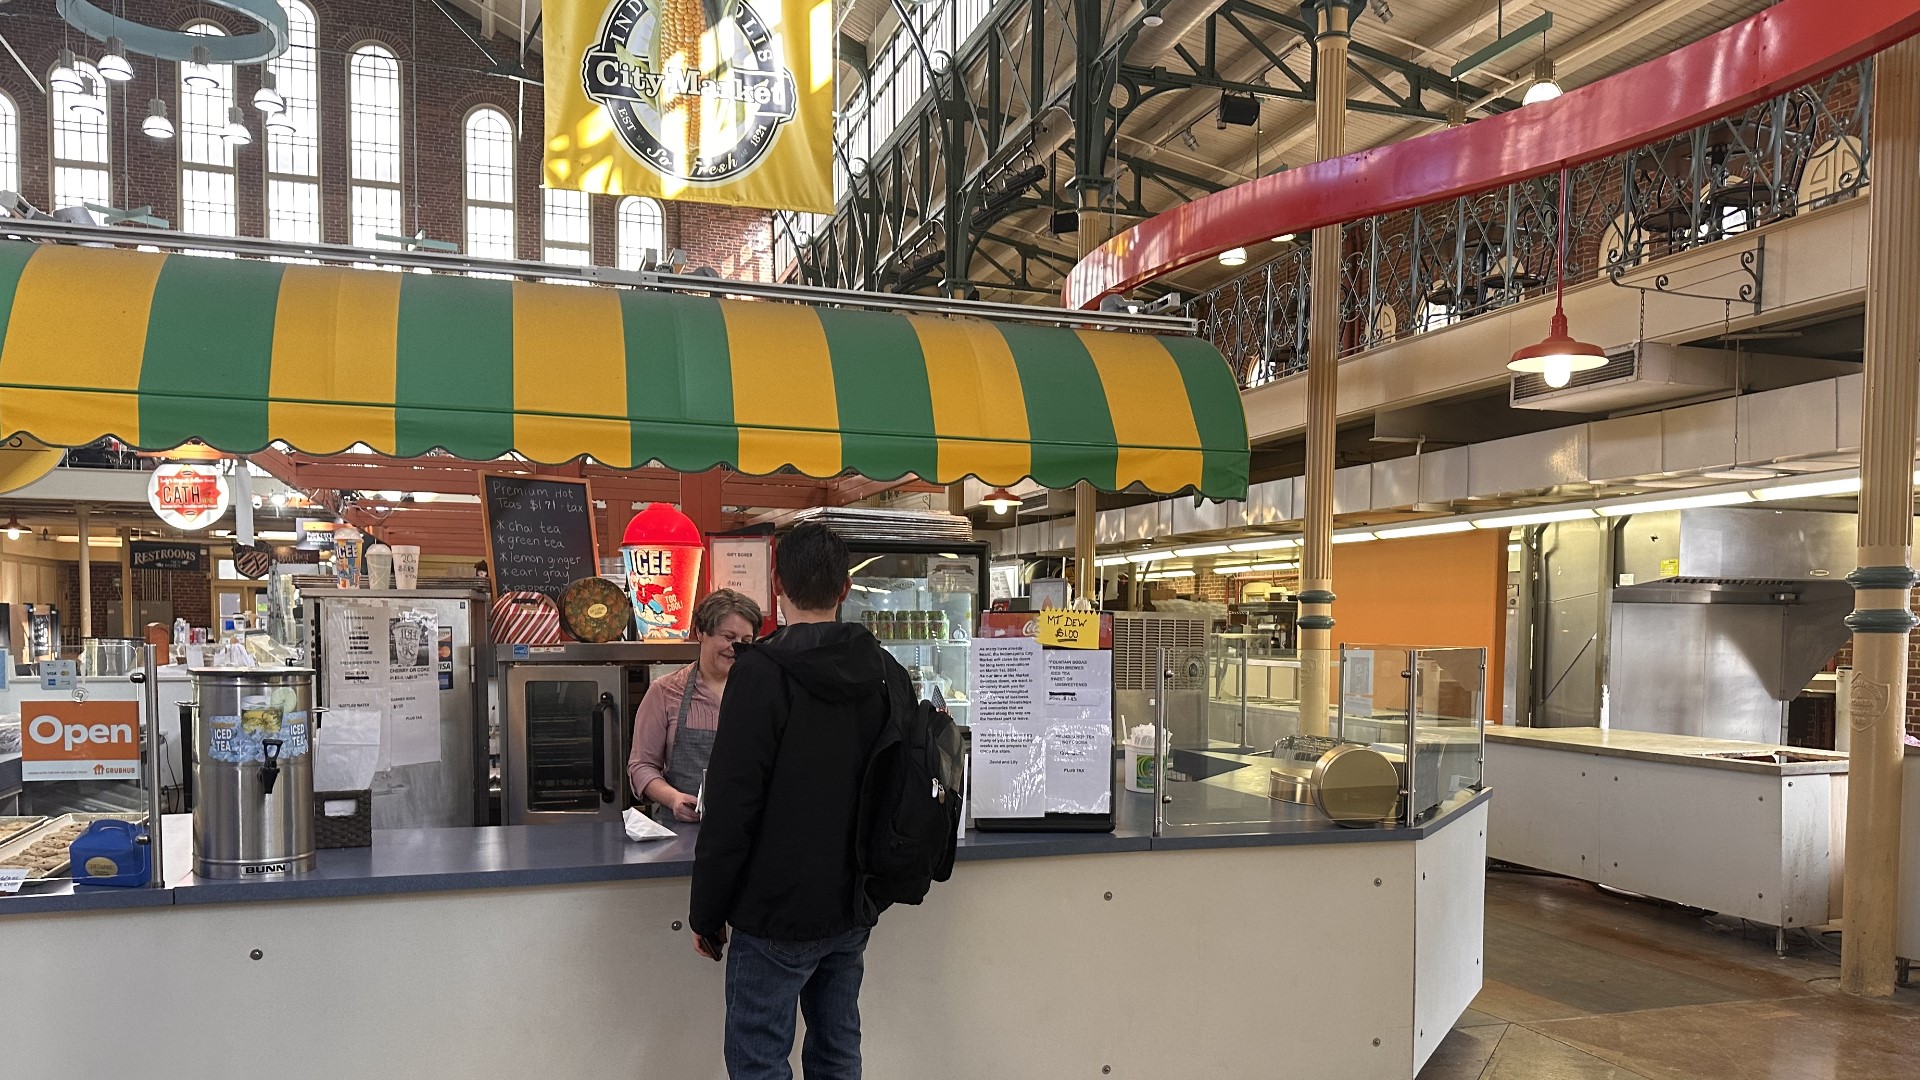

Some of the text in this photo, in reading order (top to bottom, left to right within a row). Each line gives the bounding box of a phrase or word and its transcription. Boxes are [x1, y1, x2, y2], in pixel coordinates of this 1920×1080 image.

[595, 60, 783, 105] City Market
[617, 107, 637, 132] EST
[750, 125, 768, 147] 1821
[163, 486, 200, 503] CATH
[492, 481, 574, 499] Premium Hot
[495, 497, 523, 510] Teas
[566, 502, 584, 513] tax
[508, 520, 562, 534] chai tea
[507, 536, 565, 549] green tea
[134, 549, 196, 565] RESTROOMS
[336, 545, 358, 559] ICEE
[510, 551, 582, 570] lemon ginger
[630, 549, 672, 577] ICEE
[511, 567, 570, 586] earl gray
[664, 594, 677, 603] TOO
[666, 600, 684, 612] COOL!
[1047, 614, 1088, 628] MT DEW
[28, 715, 133, 752] Open
[214, 728, 233, 740] ICED
[290, 723, 305, 736] ICED
[215, 740, 232, 752] TEA
[291, 735, 306, 747] TEA
[245, 863, 287, 874] BUNN
